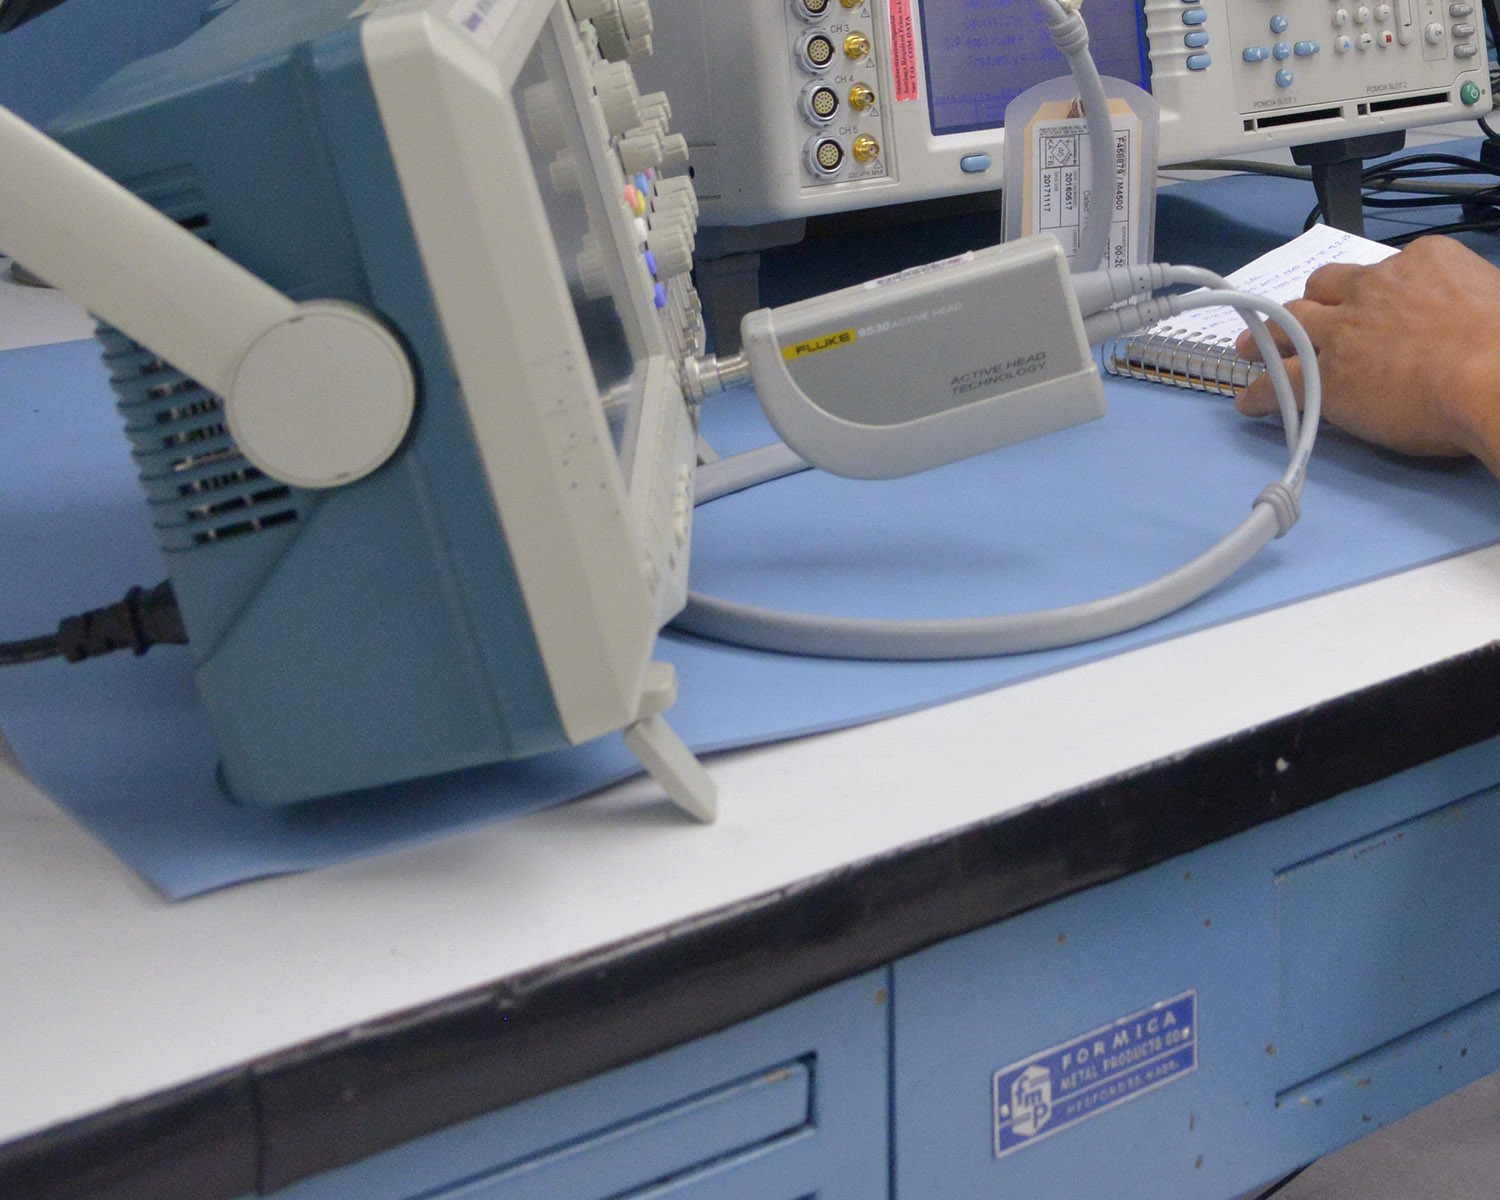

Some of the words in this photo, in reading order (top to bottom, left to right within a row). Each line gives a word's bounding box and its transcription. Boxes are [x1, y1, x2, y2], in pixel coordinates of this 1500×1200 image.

[831, 25, 842, 33] CH
[844, 24, 849, 32] 3
[896, 15, 905, 33] Prior
[905, 16, 913, 38] DATA
[896, 35, 909, 65] Required
[907, 40, 915, 59] COM
[835, 76, 847, 84] CH
[848, 75, 854, 83] 4
[1367, 85, 1388, 93] PCMCIA
[1389, 83, 1401, 91] SLOT
[1253, 99, 1275, 107] PCMCIA
[1277, 98, 1291, 106] SLOT
[839, 126, 851, 134] CH
[852, 125, 858, 133] 5
[1044, 175, 1052, 212] 20171117
[1116, 182, 1124, 211] M4500
[796, 333, 850, 355] FLUKE
[858, 322, 890, 338] 9530
[890, 312, 928, 329] ACTIVE
[932, 303, 963, 318] HEAD
[952, 364, 1001, 385] ACTIVE
[1007, 352, 1045, 369] HEAD
[952, 362, 1046, 394] TECHNOLOGY
[1062, 1011, 1177, 1070] FORMICA
